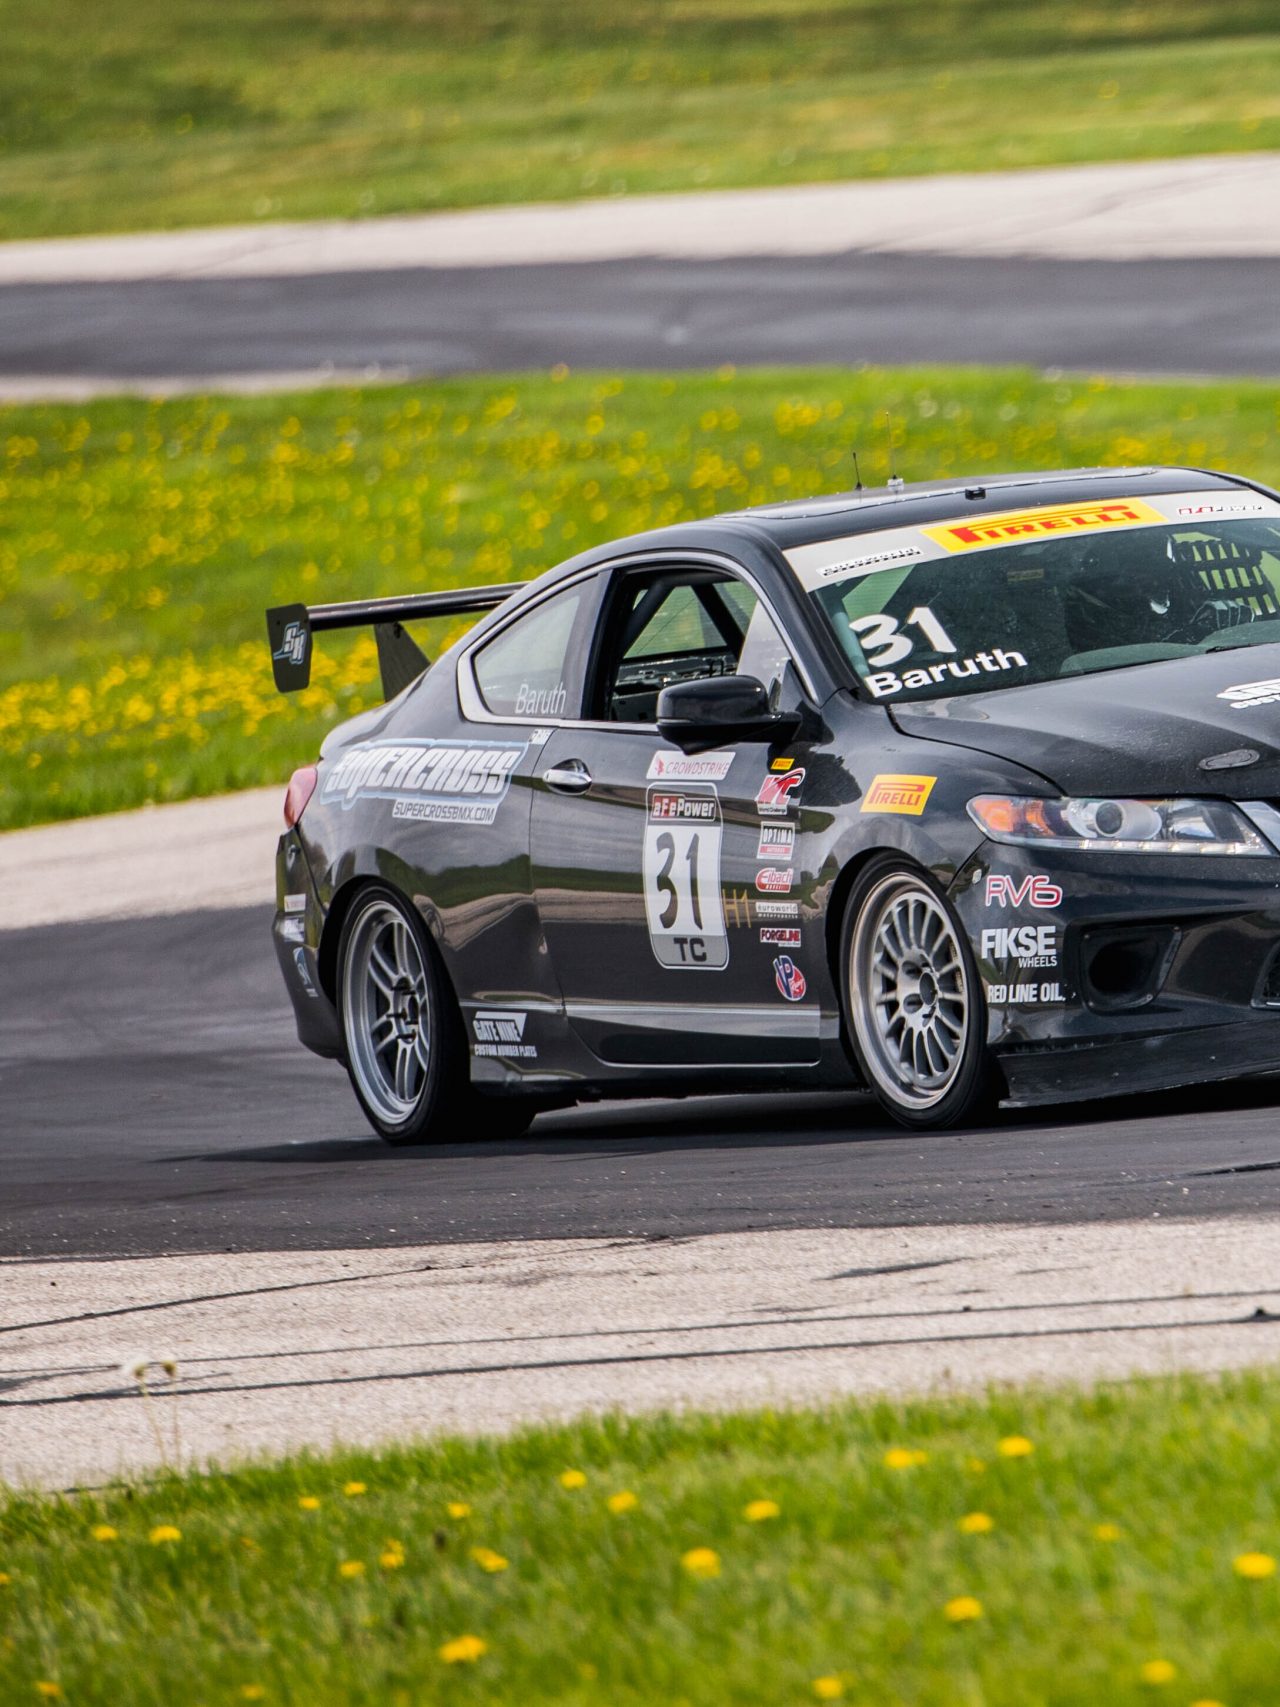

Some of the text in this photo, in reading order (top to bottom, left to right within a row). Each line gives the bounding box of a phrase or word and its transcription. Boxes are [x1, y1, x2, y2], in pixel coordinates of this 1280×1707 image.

[948, 504, 1141, 543] PIRELLI
[849, 606, 957, 667] 31
[864, 648, 1028, 698] Baruth
[515, 682, 567, 714] Baruth
[666, 761, 729, 776] CROWDSTRIKE
[868, 783, 925, 806] PIRELLI
[393, 801, 495, 822] SUPERCROSSBMX.COM
[762, 828, 793, 843] OPTIMA
[655, 831, 703, 931] 31
[985, 875, 1063, 908] RV6
[757, 903, 797, 913] euroworld
[761, 929, 800, 942] FORGELINE
[981, 926, 1057, 959] FIKSE
[674, 937, 708, 962] TC
[1018, 956, 1058, 968] WHEELS
[987, 985, 1007, 1003] RED
[1008, 983, 1038, 1003] LINE
